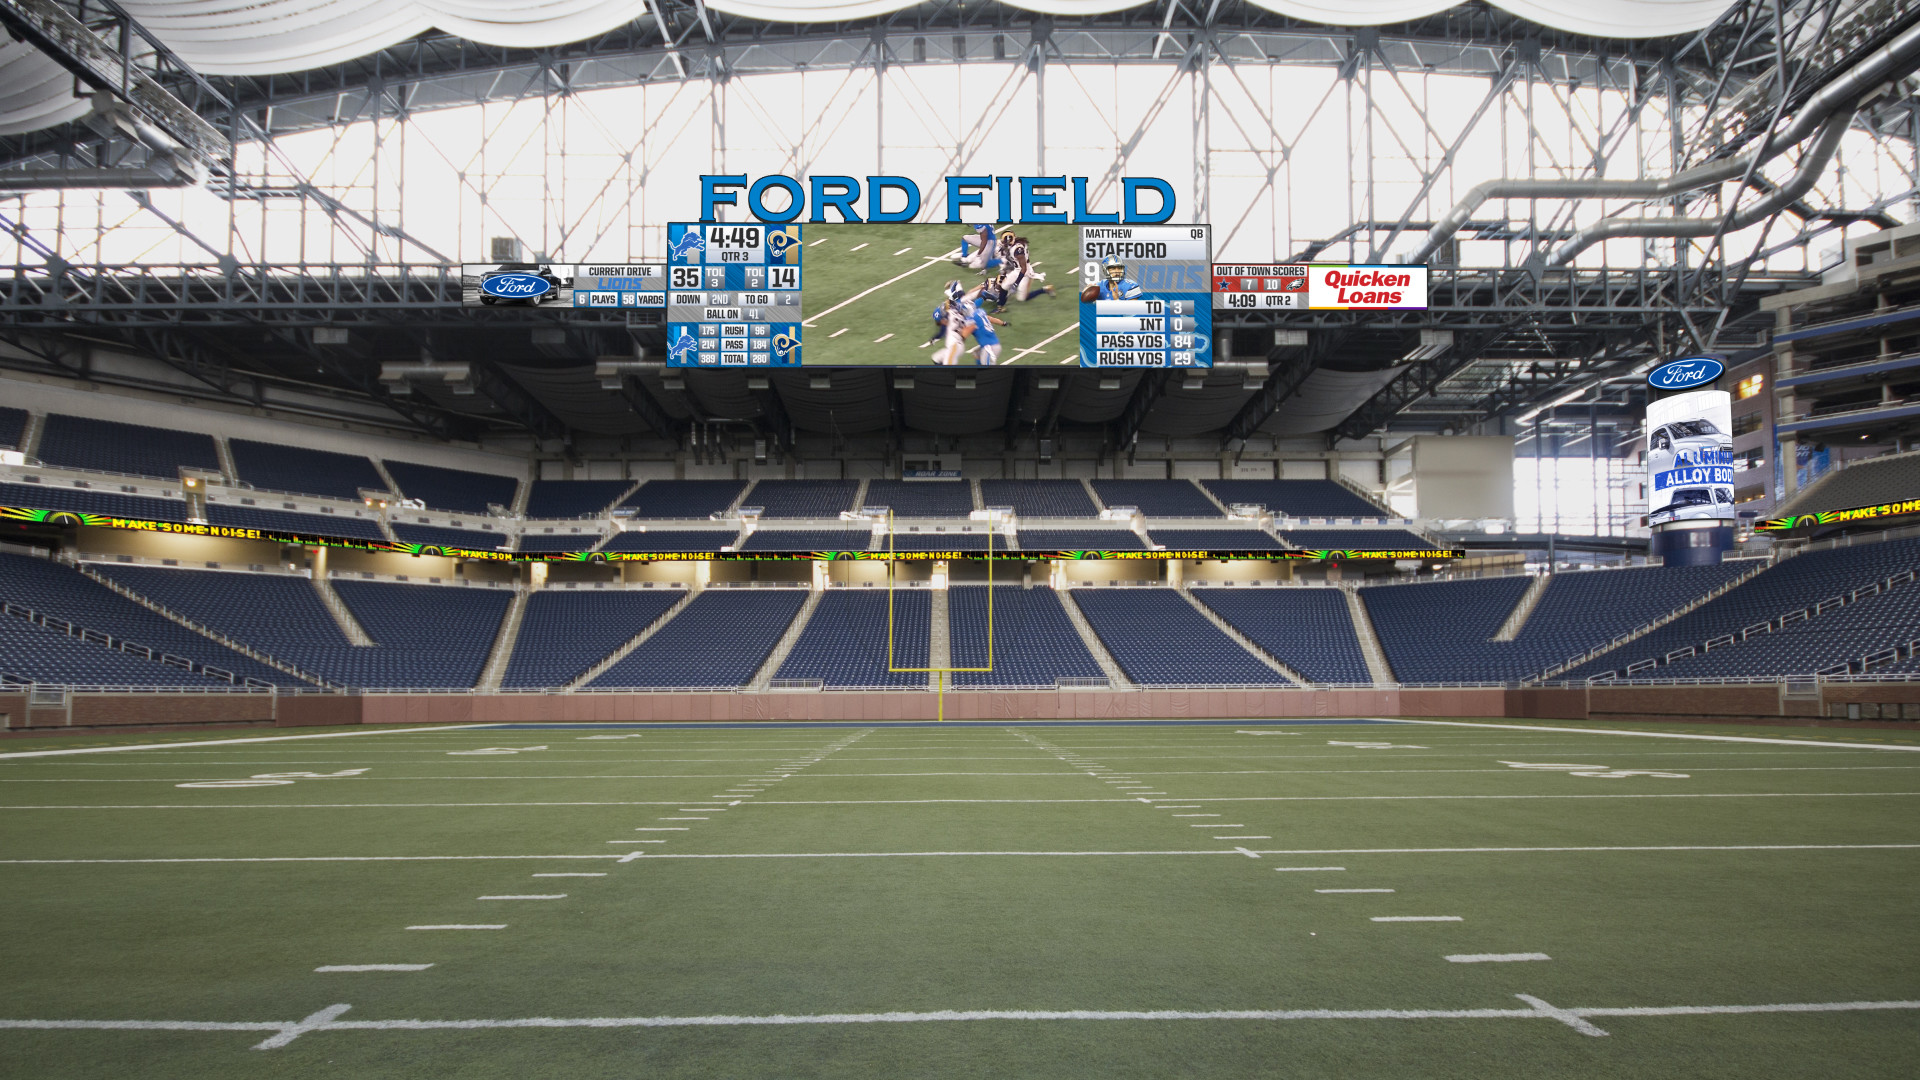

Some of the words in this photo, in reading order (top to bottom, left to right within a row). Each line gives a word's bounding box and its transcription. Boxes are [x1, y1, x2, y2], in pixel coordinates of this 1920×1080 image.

[699, 174, 921, 223] FORD
[945, 175, 1176, 224] FIELD
[710, 227, 760, 248] 4:49
[1085, 229, 1132, 239] MATTHEW
[1190, 229, 1203, 239] QB
[1086, 242, 1167, 259] STAFFORD
[721, 252, 741, 262] QTR
[742, 252, 749, 262] 3
[588, 267, 626, 276] CURRENT
[627, 267, 651, 276] DRIVE
[705, 268, 725, 277] TOL
[745, 268, 765, 277] TOL
[1084, 262, 1100, 286] 9
[1216, 266, 1233, 275] OUT
[1234, 266, 1245, 275] OF
[1246, 266, 1271, 275] TOWN
[1272, 266, 1305, 276] SCORES
[673, 268, 699, 288] 35
[772, 268, 796, 288] 14
[1124, 265, 1205, 289] IONS
[1324, 270, 1411, 289] Quicken
[496, 277, 536, 293] Ford
[711, 279, 719, 288] 3
[751, 279, 758, 288] 2
[1246, 280, 1252, 290] 7
[1266, 280, 1277, 290] 10
[578, 293, 585, 304] 6
[591, 292, 616, 304] PLAYS
[622, 292, 635, 304] 58
[638, 292, 664, 304] YARDS
[676, 295, 700, 304] DOWN
[711, 294, 729, 305] 2ND
[745, 295, 756, 304] TO
[757, 295, 768, 304] GO
[785, 294, 791, 305] 2
[1228, 294, 1257, 307] 4:09
[1265, 296, 1283, 307] QTR
[1284, 296, 1291, 306] 2
[1337, 288, 1402, 304] Loans
[1145, 302, 1163, 313] TD
[1173, 302, 1182, 314] 3
[706, 309, 725, 319] BALL
[727, 309, 739, 319] ON
[749, 310, 759, 320] 41
[1139, 318, 1163, 331] INT
[702, 326, 715, 335] 175
[724, 326, 744, 335] RUSH
[754, 326, 765, 335] 96
[701, 340, 715, 349] 214
[725, 340, 744, 349] PASS
[753, 340, 767, 349] 184
[1101, 335, 1134, 348] PASS
[1137, 335, 1163, 348] YDS
[1174, 335, 1192, 348] 84
[701, 354, 716, 363] 389
[724, 354, 745, 363] TOTAL
[753, 354, 767, 363] 280
[1099, 352, 1134, 365] RUSH
[1137, 352, 1163, 365] YDS
[1174, 352, 1192, 365] 29
[1663, 363, 1706, 385] Ford
[1666, 468, 1711, 486] ALLOY
[1714, 468, 1733, 482] BOD
[1839, 507, 1877, 522] MAKE
[1881, 499, 1920, 515] SOME
[112, 519, 157, 531] MAKE
[163, 522, 205, 535] SOME
[210, 526, 261, 539] NOISE!
[460, 549, 489, 559] MAKE
[491, 552, 512, 561] SOM
[682, 552, 715, 560] NOISE!
[929, 552, 962, 560] NOISE!
[1117, 552, 1143, 560] MAKE
[1175, 551, 1208, 559] NOISE!
[1362, 551, 1388, 559] MAKE
[1419, 550, 1452, 558] NOISE!
